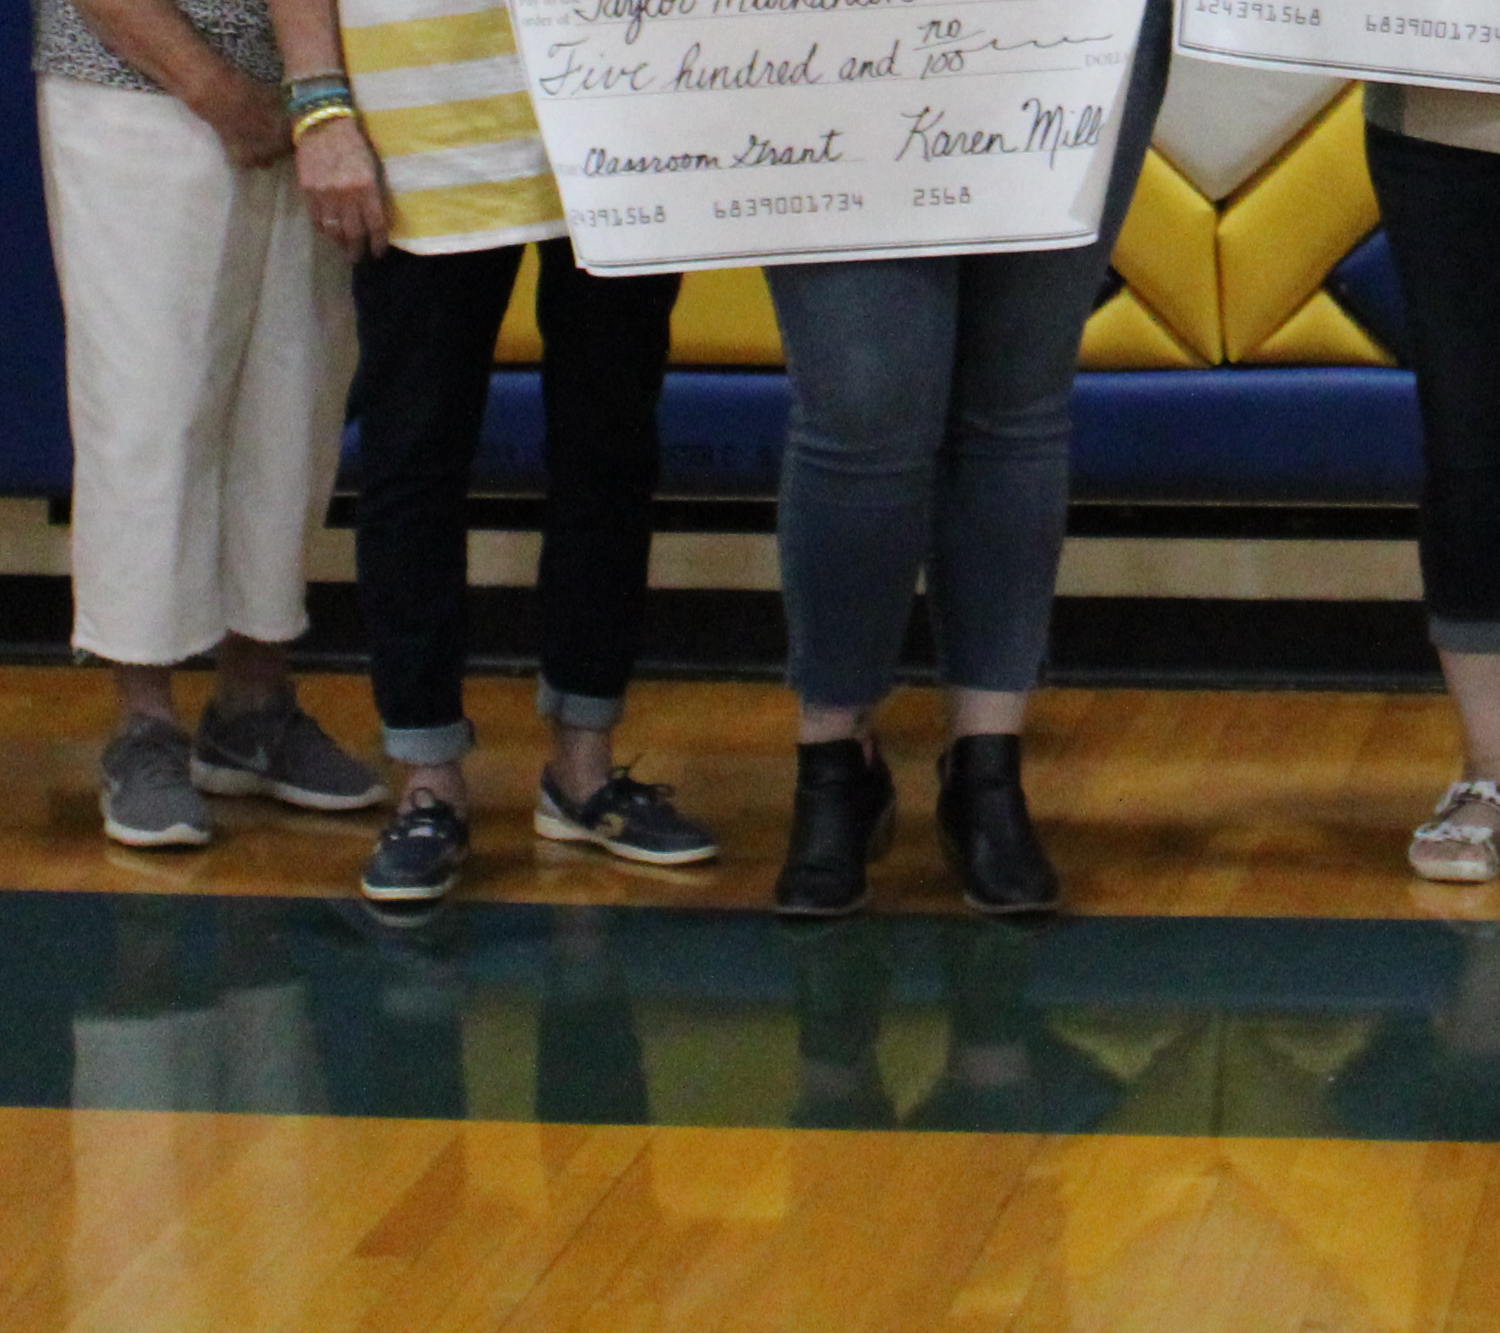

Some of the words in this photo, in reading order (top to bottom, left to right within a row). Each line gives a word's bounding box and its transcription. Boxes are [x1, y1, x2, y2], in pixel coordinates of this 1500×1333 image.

[537, 36, 654, 96] Five
[838, 38, 903, 81] and
[581, 147, 723, 178] Classroom
[729, 129, 845, 170] Grant
[894, 105, 1018, 163] Karen
[1021, 97, 1104, 171] Mill
[713, 193, 865, 220] 6839001734
[912, 186, 972, 207] 2568
